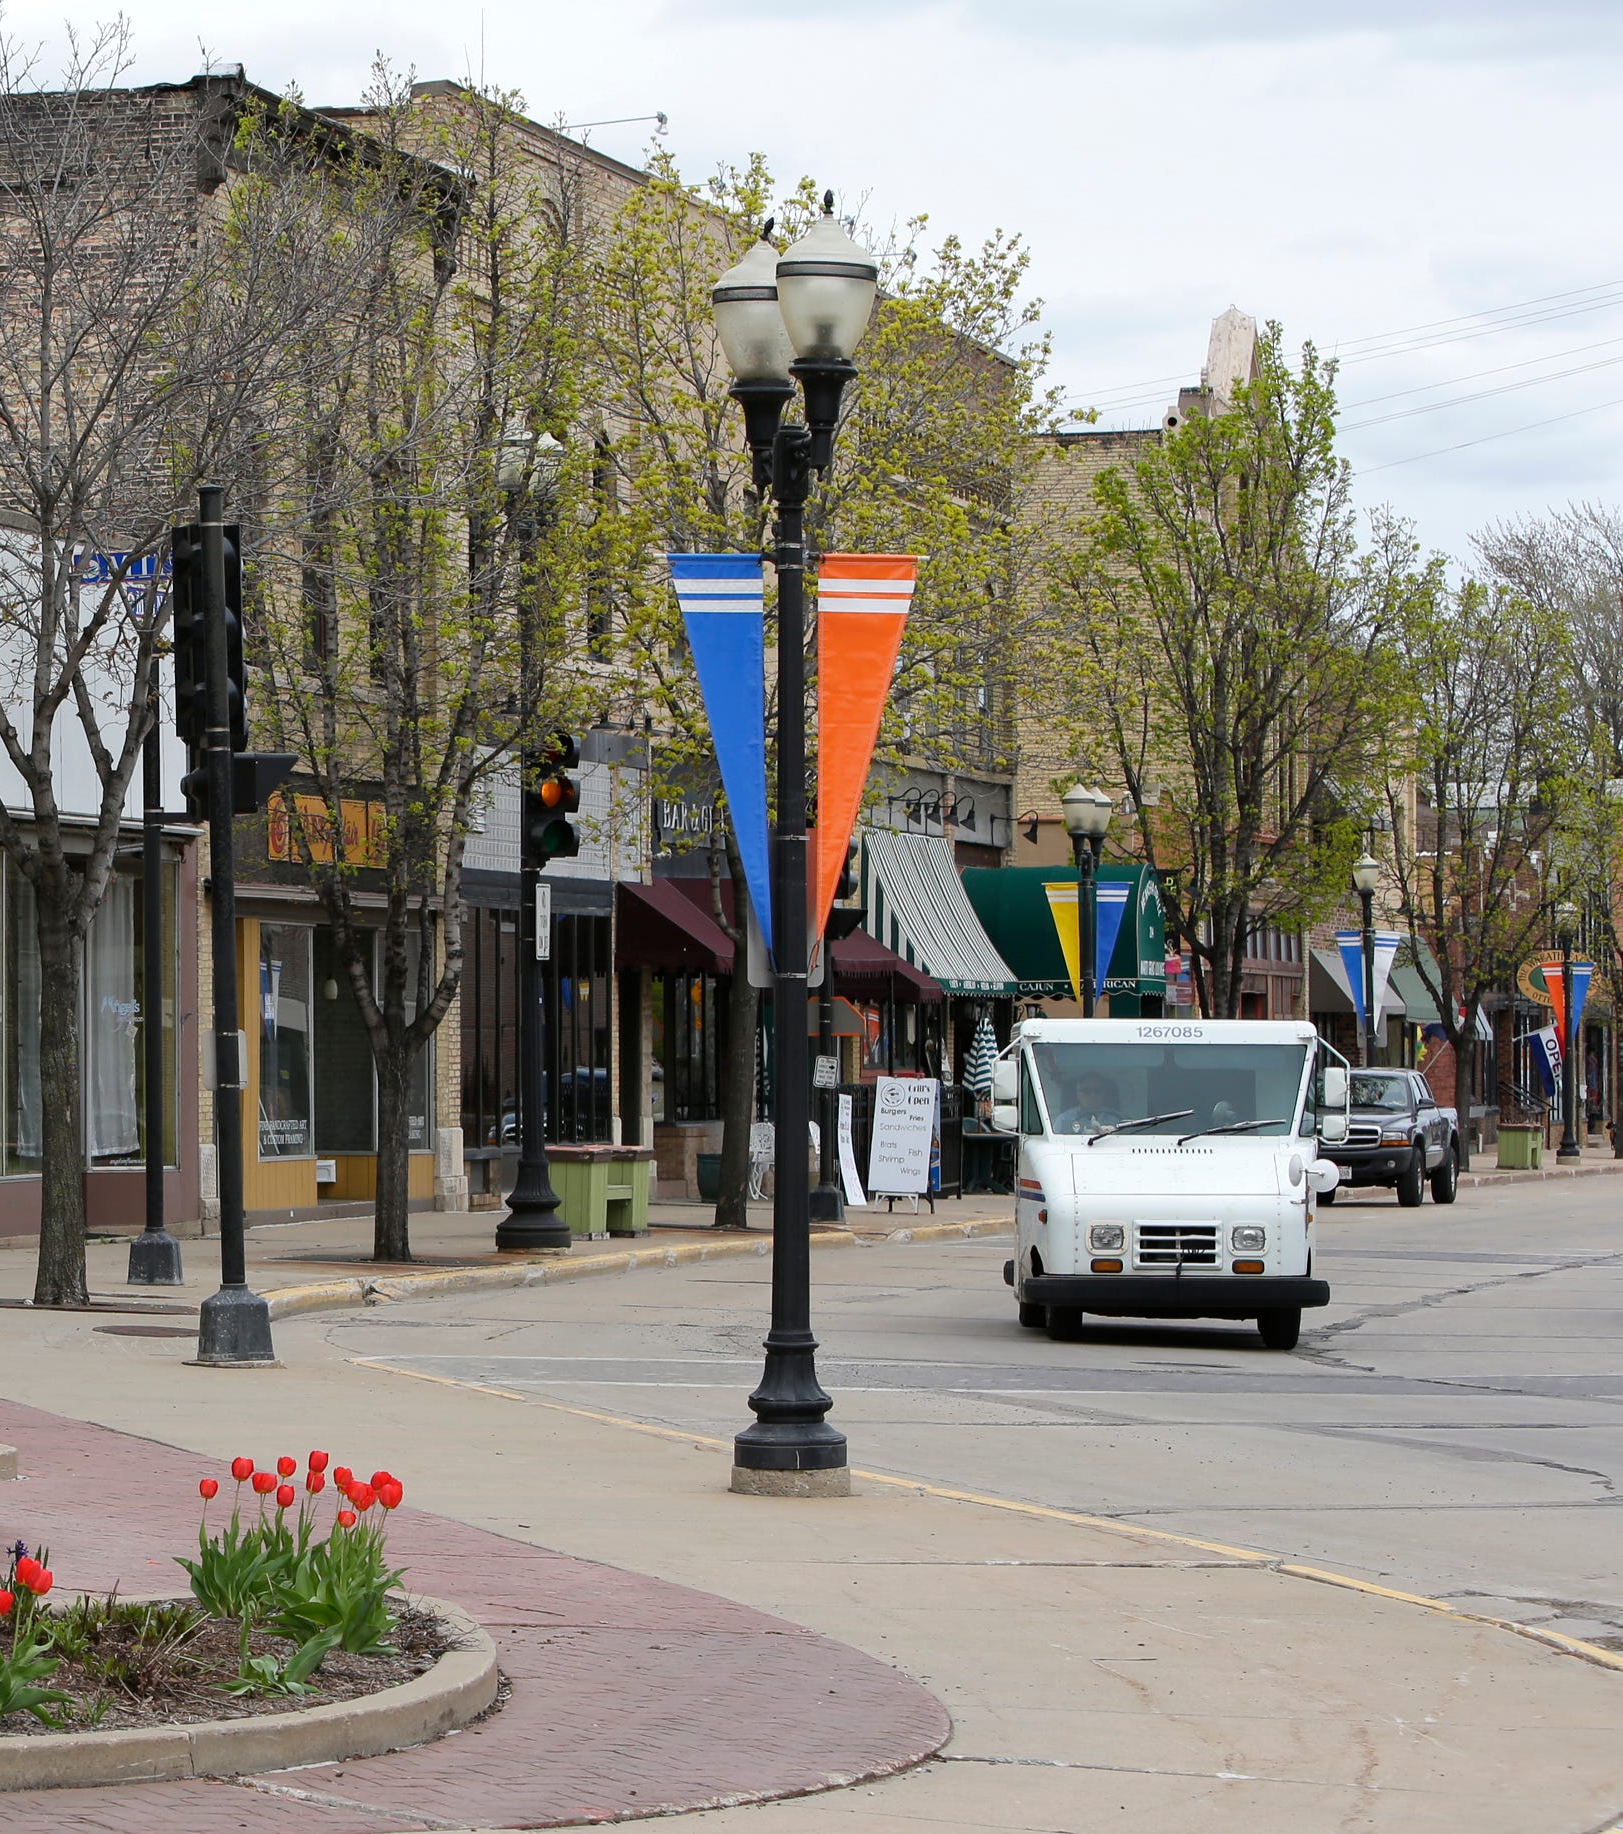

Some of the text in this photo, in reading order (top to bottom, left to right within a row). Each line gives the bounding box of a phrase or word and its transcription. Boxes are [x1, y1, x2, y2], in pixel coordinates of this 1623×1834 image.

[663, 799, 689, 831] BAR
[1019, 982, 1054, 992] CAJUN
[1136, 1026, 1204, 1038] 1267085
[1545, 1039, 1561, 1078] OPE
[880, 1107, 907, 1116] Burgers
[880, 1123, 927, 1132] Sandwiches
[880, 1141, 898, 1149] Brats
[908, 1148, 924, 1158] Fish
[878, 1154, 906, 1165] Shrimp
[900, 1166, 922, 1176] Wings
